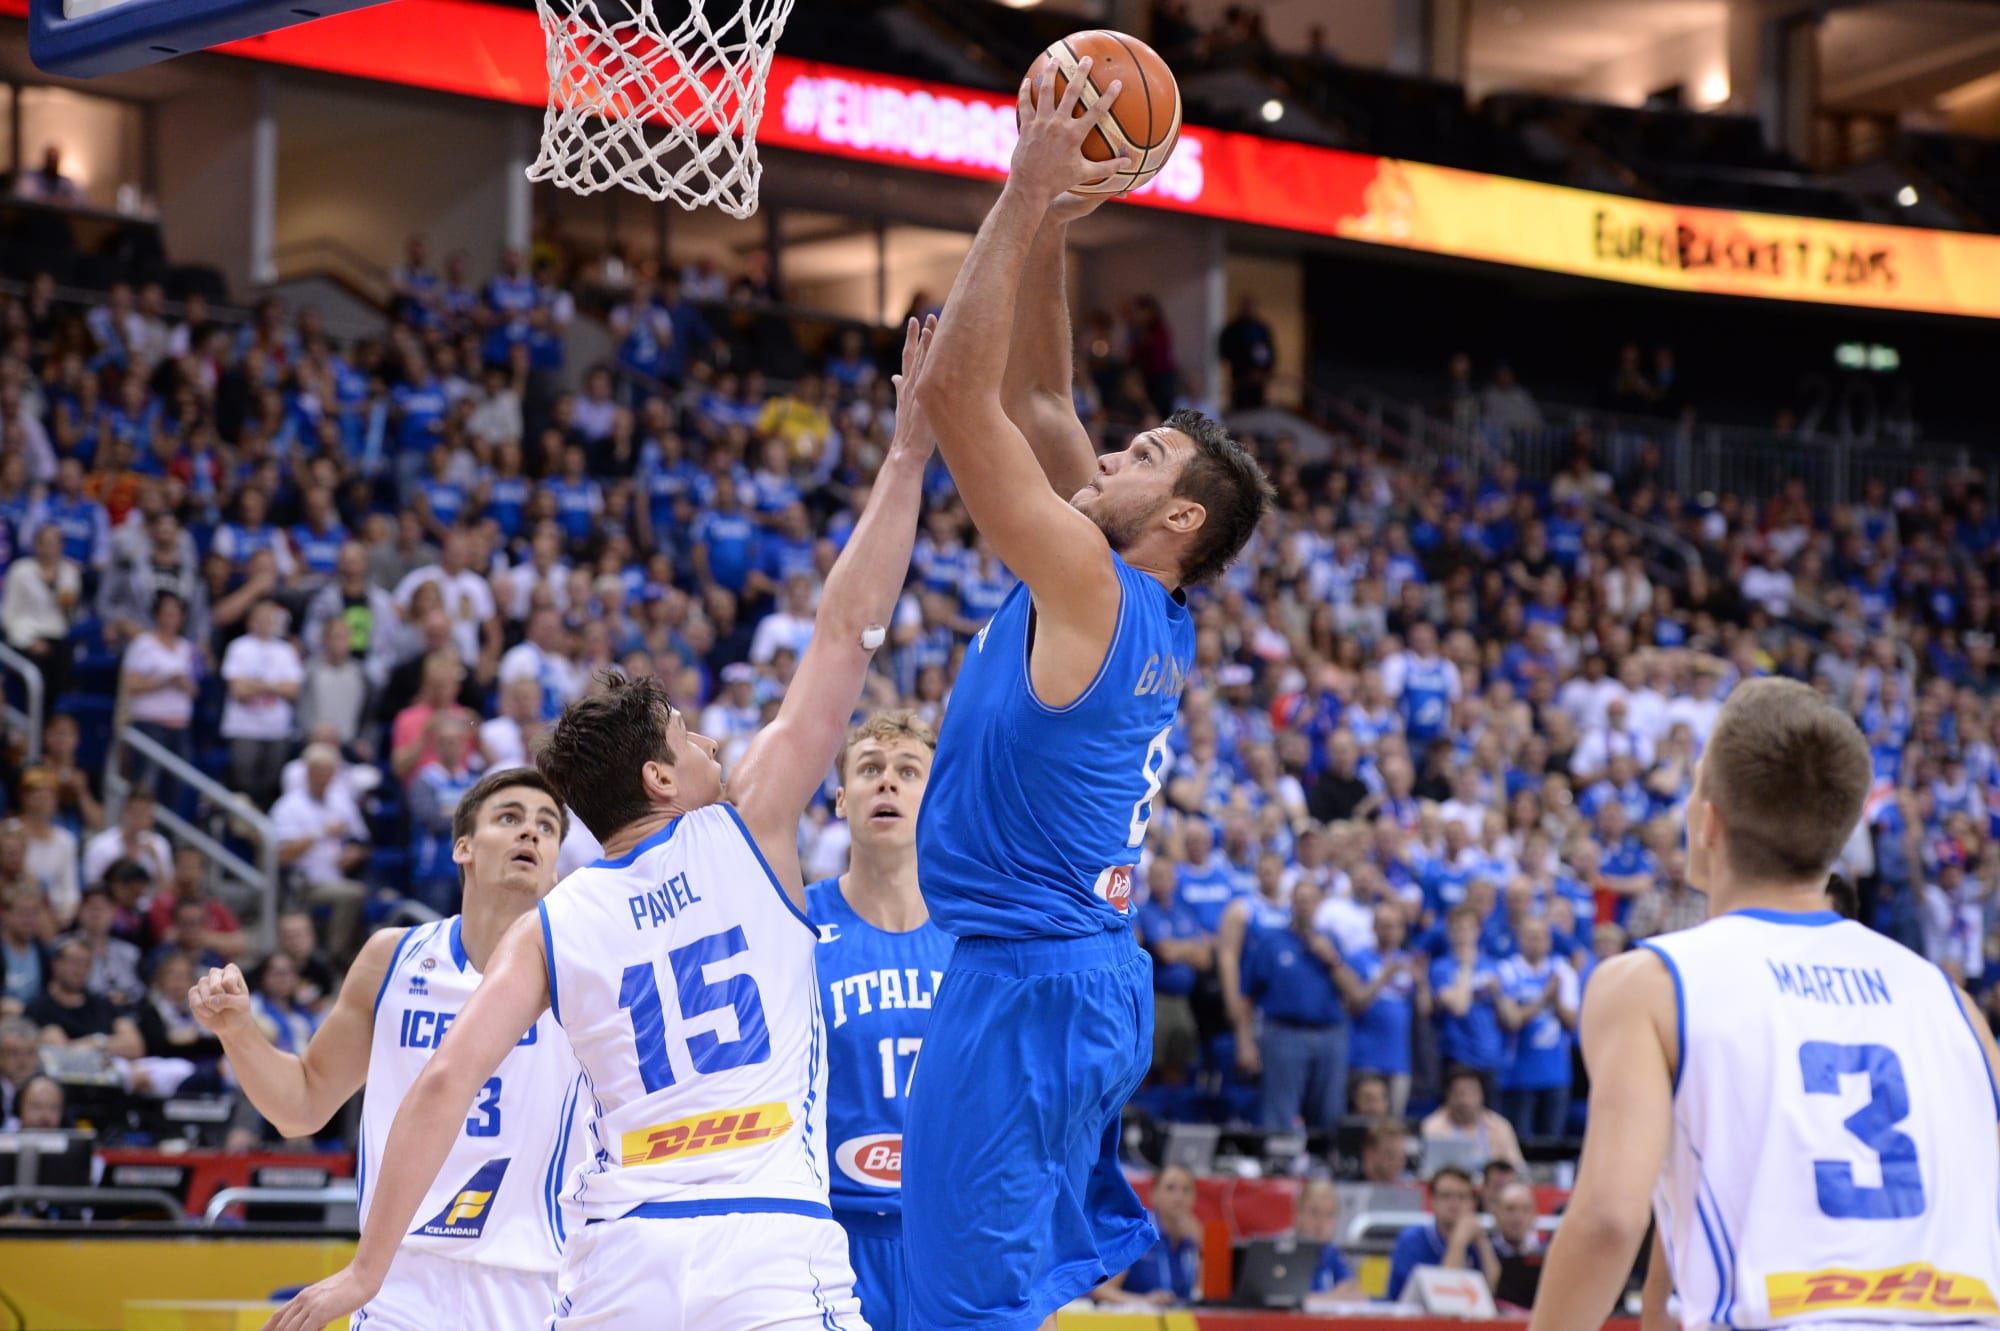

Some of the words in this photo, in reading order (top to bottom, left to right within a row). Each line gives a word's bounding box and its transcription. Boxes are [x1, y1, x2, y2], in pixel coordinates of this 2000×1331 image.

[628, 871, 702, 930] PAVEL
[1766, 958, 1894, 1006] MARTIN
[618, 924, 772, 1096] 15
[646, 1112, 771, 1160] DHL
[1799, 1040, 1926, 1220] 3
[424, 1225, 480, 1237] ICELANDAIR
[1804, 1270, 1973, 1307] DHL
